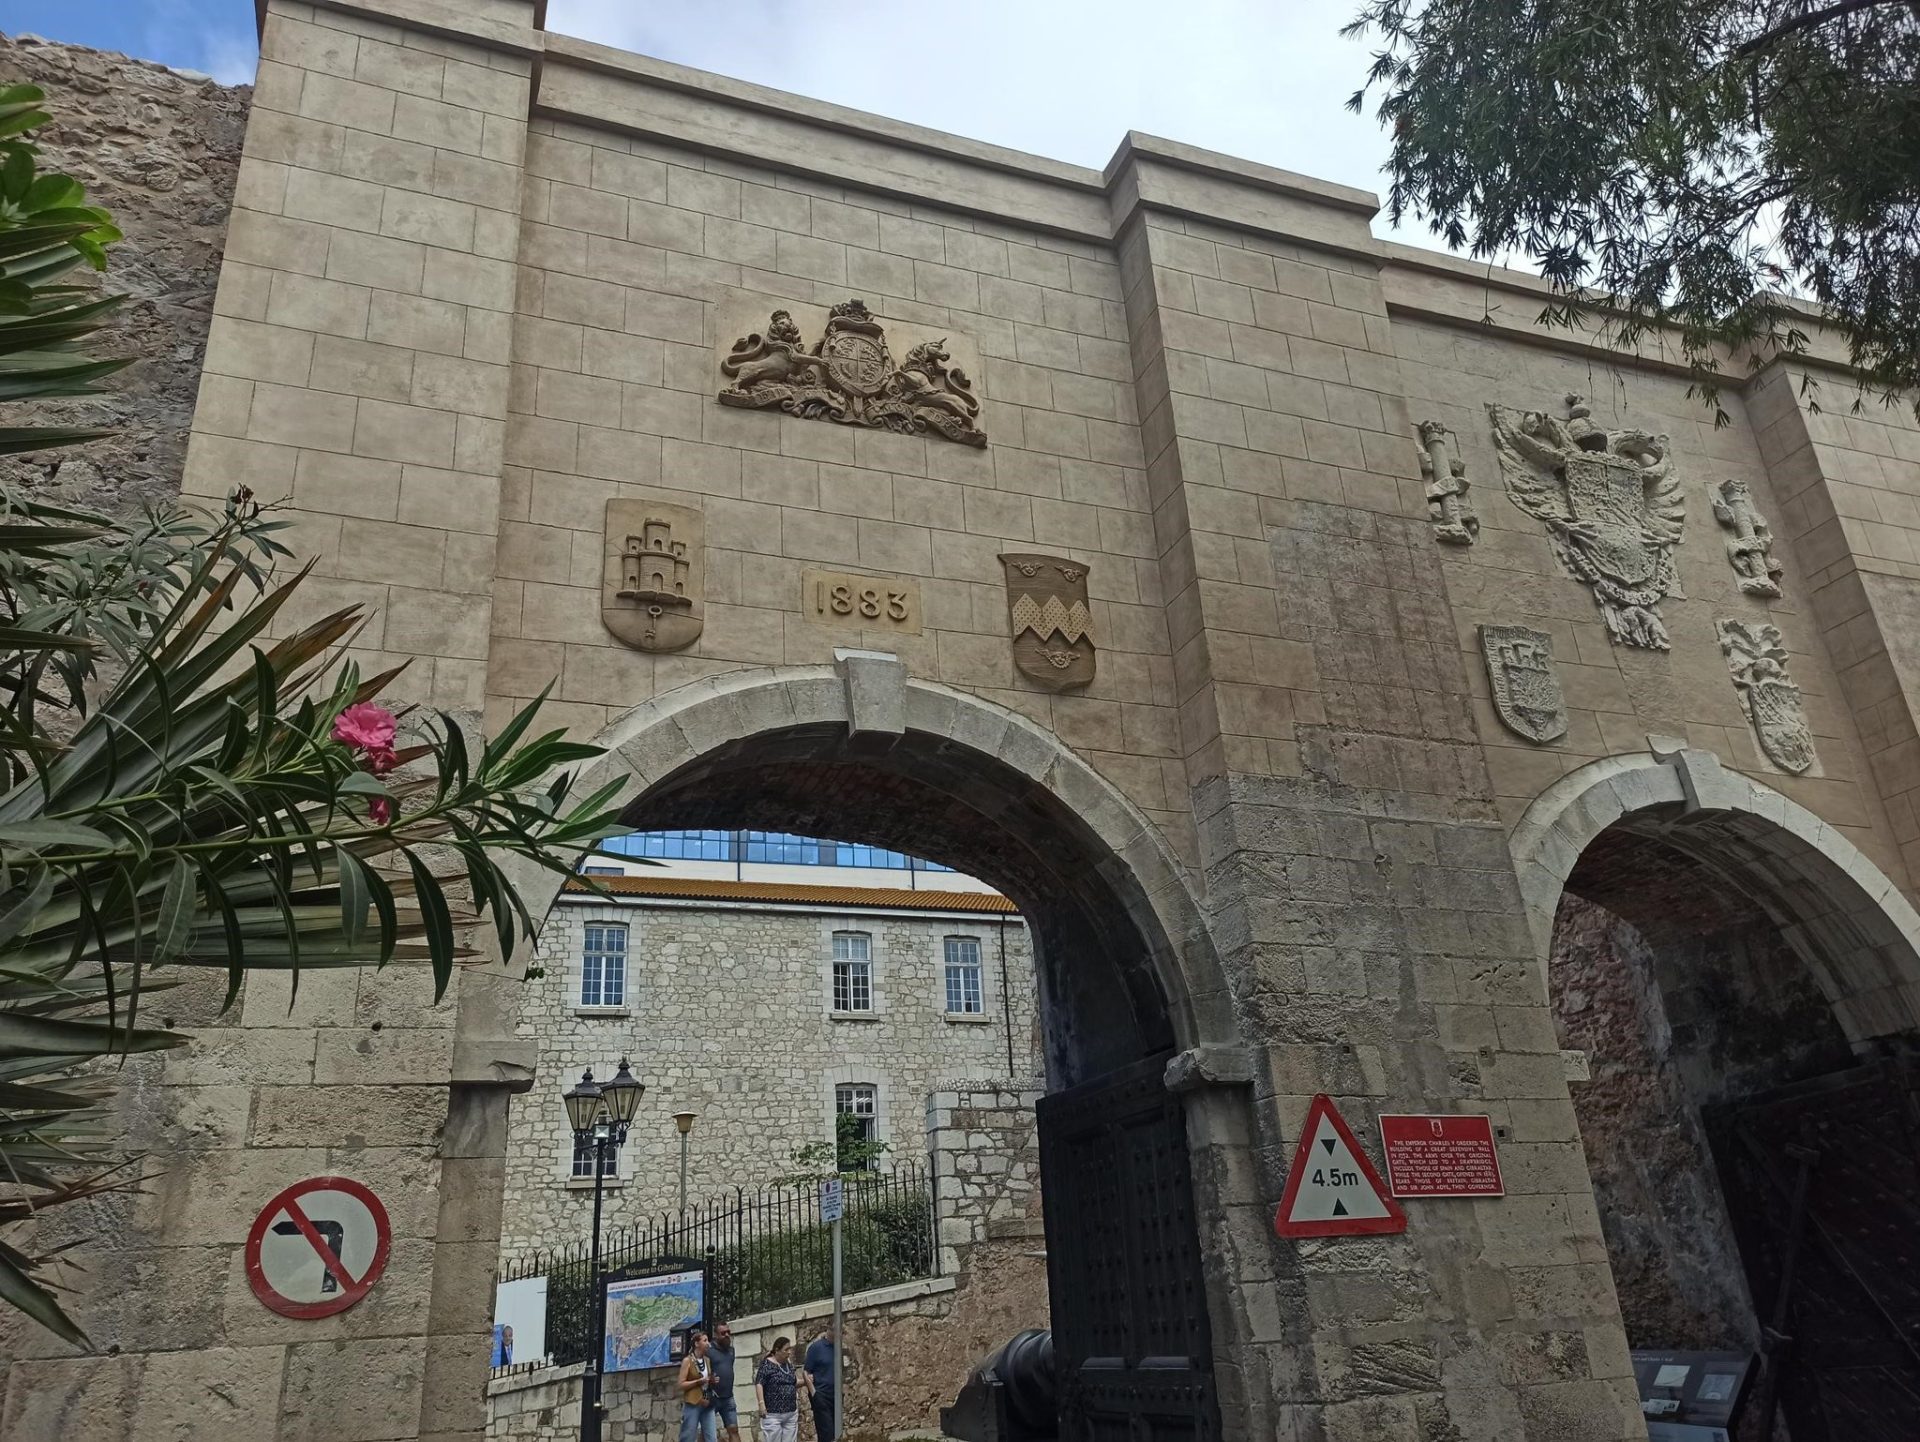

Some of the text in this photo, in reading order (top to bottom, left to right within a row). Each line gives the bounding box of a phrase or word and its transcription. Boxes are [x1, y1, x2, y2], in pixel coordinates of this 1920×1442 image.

[817, 581, 908, 621] 1883
[1312, 1168, 1359, 1187] 4.5m
[625, 1267, 649, 1276] Welcome
[657, 1263, 684, 1272] Gibraltar
